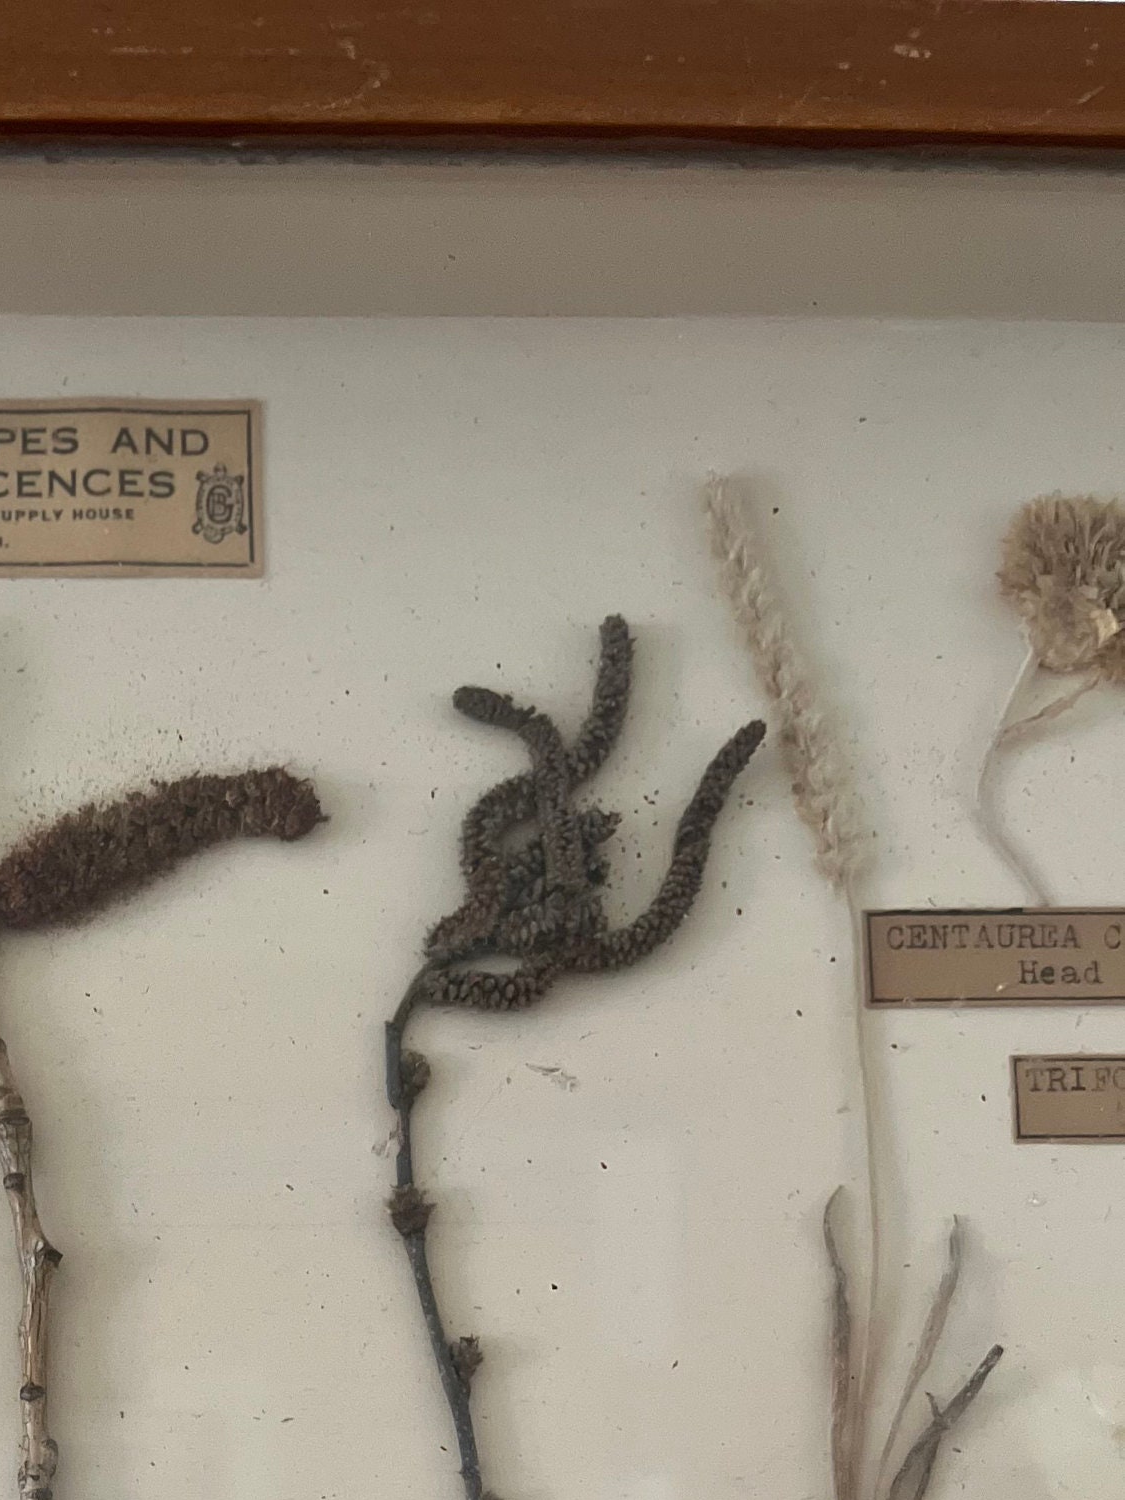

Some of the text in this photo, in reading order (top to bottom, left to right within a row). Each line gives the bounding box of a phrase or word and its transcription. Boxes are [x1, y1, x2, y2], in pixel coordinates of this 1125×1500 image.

[110, 427, 210, 456] AND
[72, 507, 135, 521] HOUSE
[886, 923, 1122, 950] CENTAUREA C
[1018, 960, 1104, 985] Head
